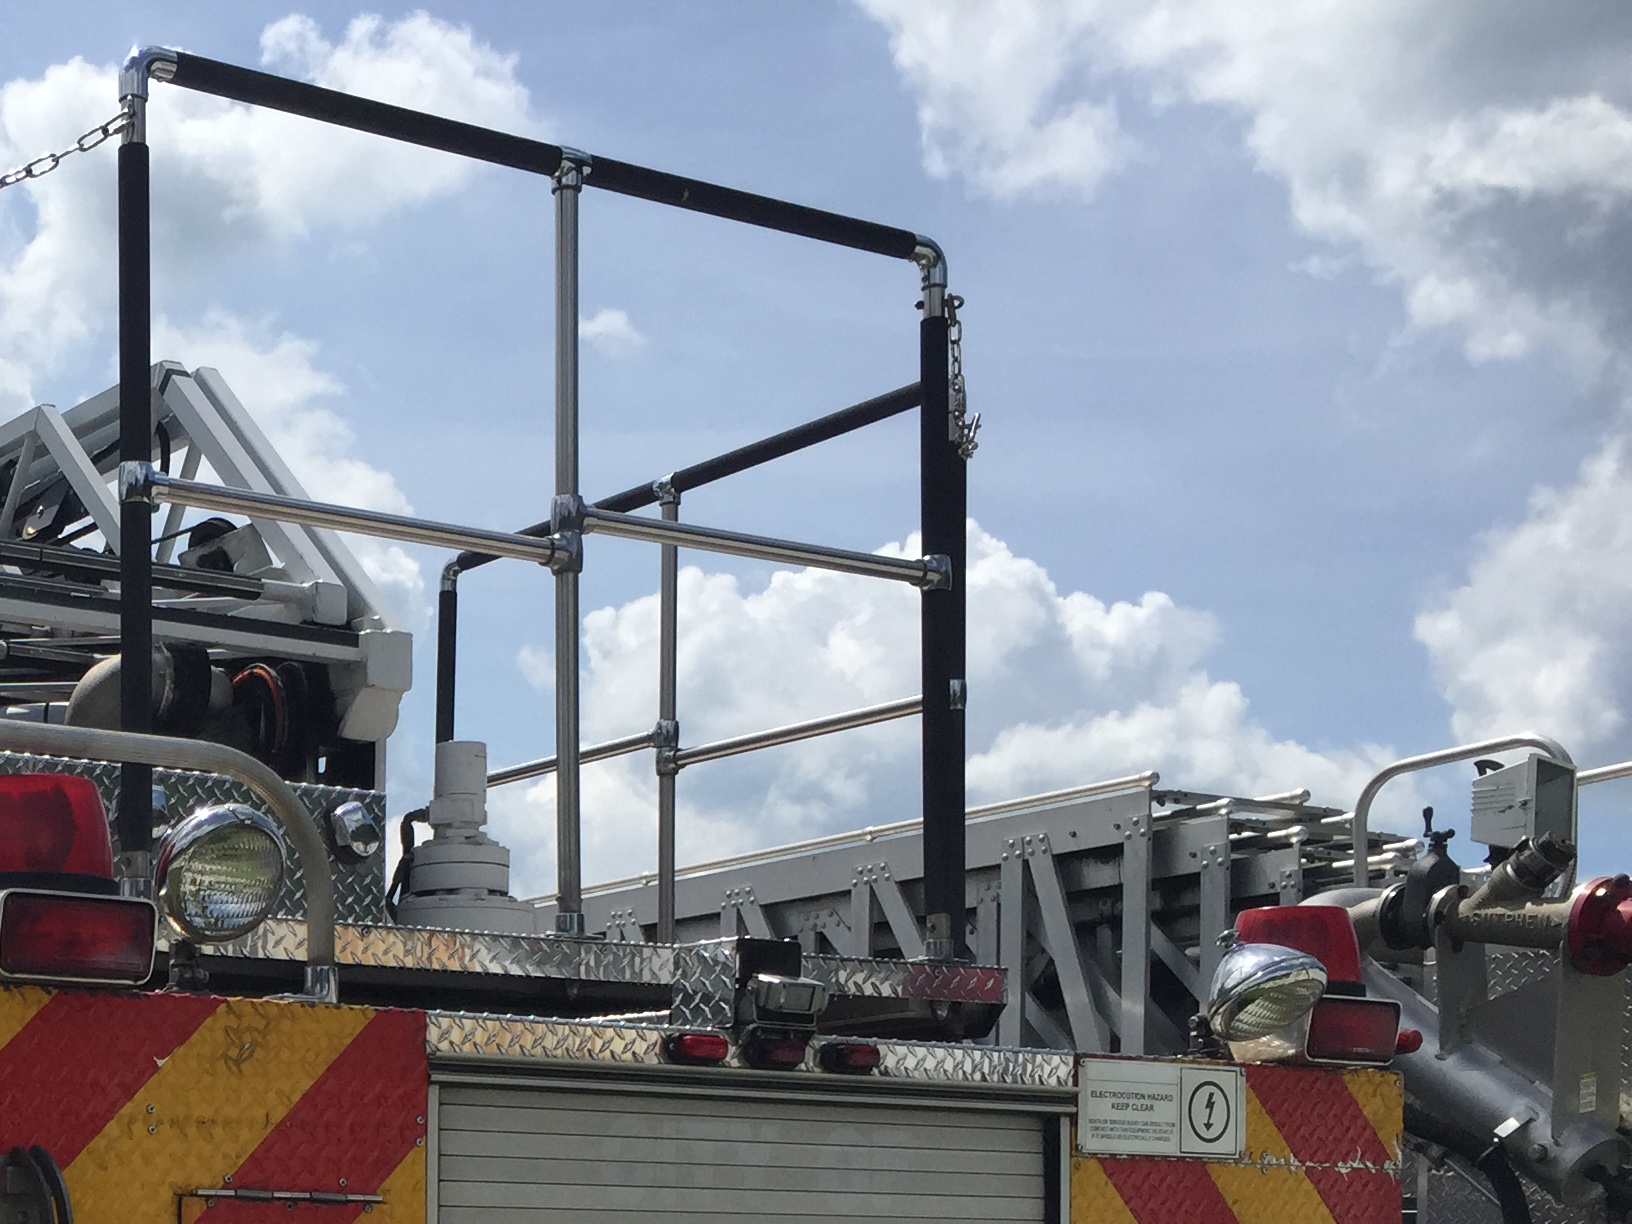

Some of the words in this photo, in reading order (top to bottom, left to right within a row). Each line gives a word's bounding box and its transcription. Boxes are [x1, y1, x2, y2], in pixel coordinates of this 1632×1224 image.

[1471, 909, 1550, 930] SUTPHEN
[1090, 1090, 1145, 1100] ELECTROCUTION
[1146, 1093, 1174, 1102] HAZARD
[1111, 1102, 1130, 1111] KEEP
[1131, 1103, 1155, 1112] CLEAR
